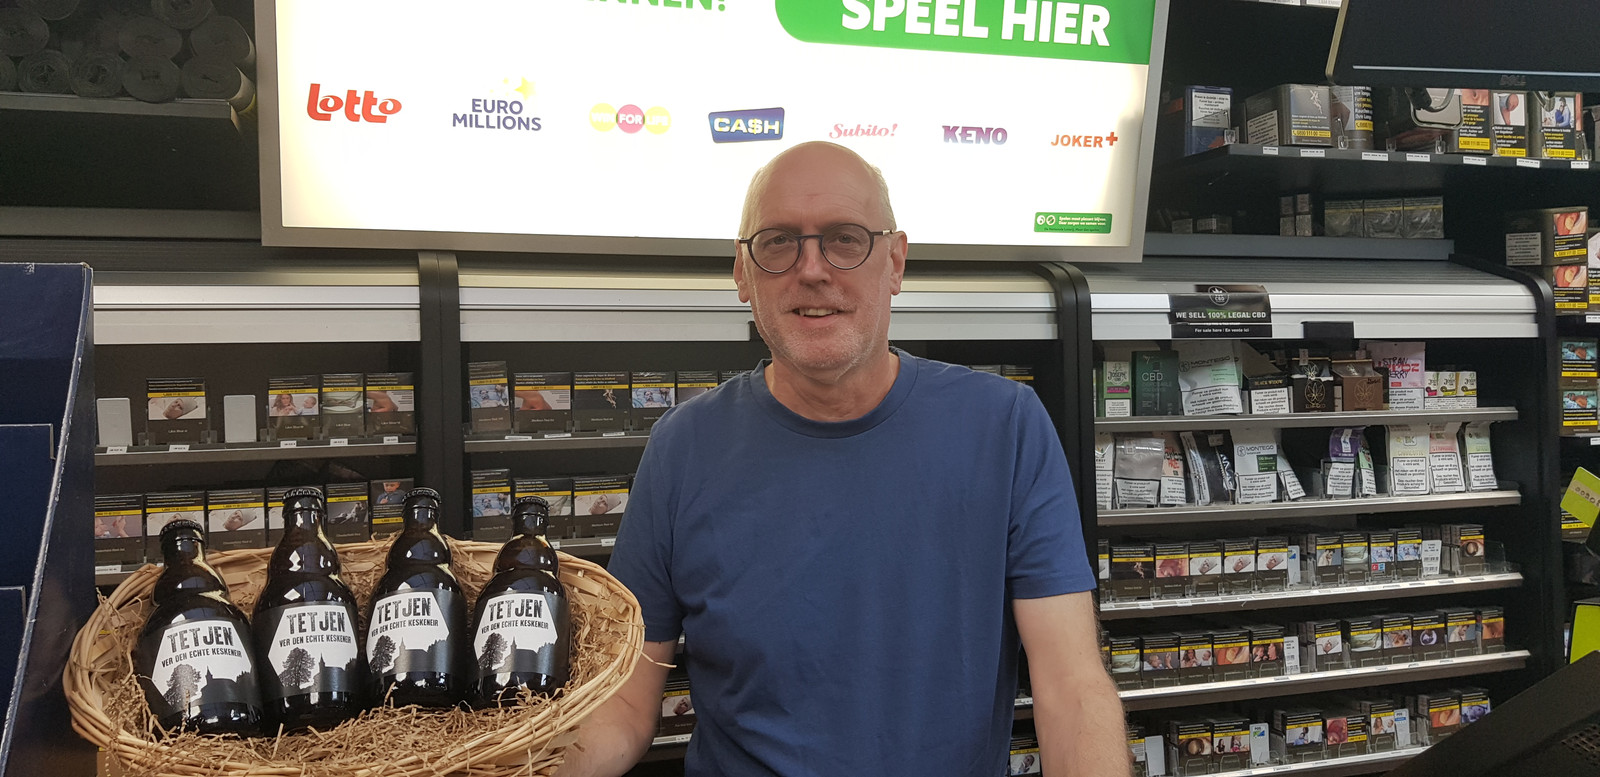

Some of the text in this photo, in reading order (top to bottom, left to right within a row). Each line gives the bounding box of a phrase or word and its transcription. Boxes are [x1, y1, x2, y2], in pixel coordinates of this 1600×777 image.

[842, 0, 1110, 47] SPEEL HIER
[471, 98, 523, 115] EURO
[452, 113, 542, 131] MILLIONS
[591, 112, 668, 126] WIN FOR LIFE
[829, 123, 898, 139] Subito!
[942, 125, 1008, 145] KENO
[1142, 372, 1164, 381] CBD
[377, 598, 431, 624] TETJEN
[489, 598, 542, 622] TETJEN
[286, 611, 346, 634] TETJEN
[380, 624, 388, 633] DEN
[390, 620, 406, 630] ECHTE
[408, 619, 439, 627] KESKENEIR
[482, 620, 549, 634] VER DEN ECHTE KESKENEIR
[168, 626, 234, 653] TETJEN
[279, 634, 351, 648] VER DEN ECHTE KESKENEIR
[161, 648, 242, 668] VER DEN ECHTE KESKENEIR
